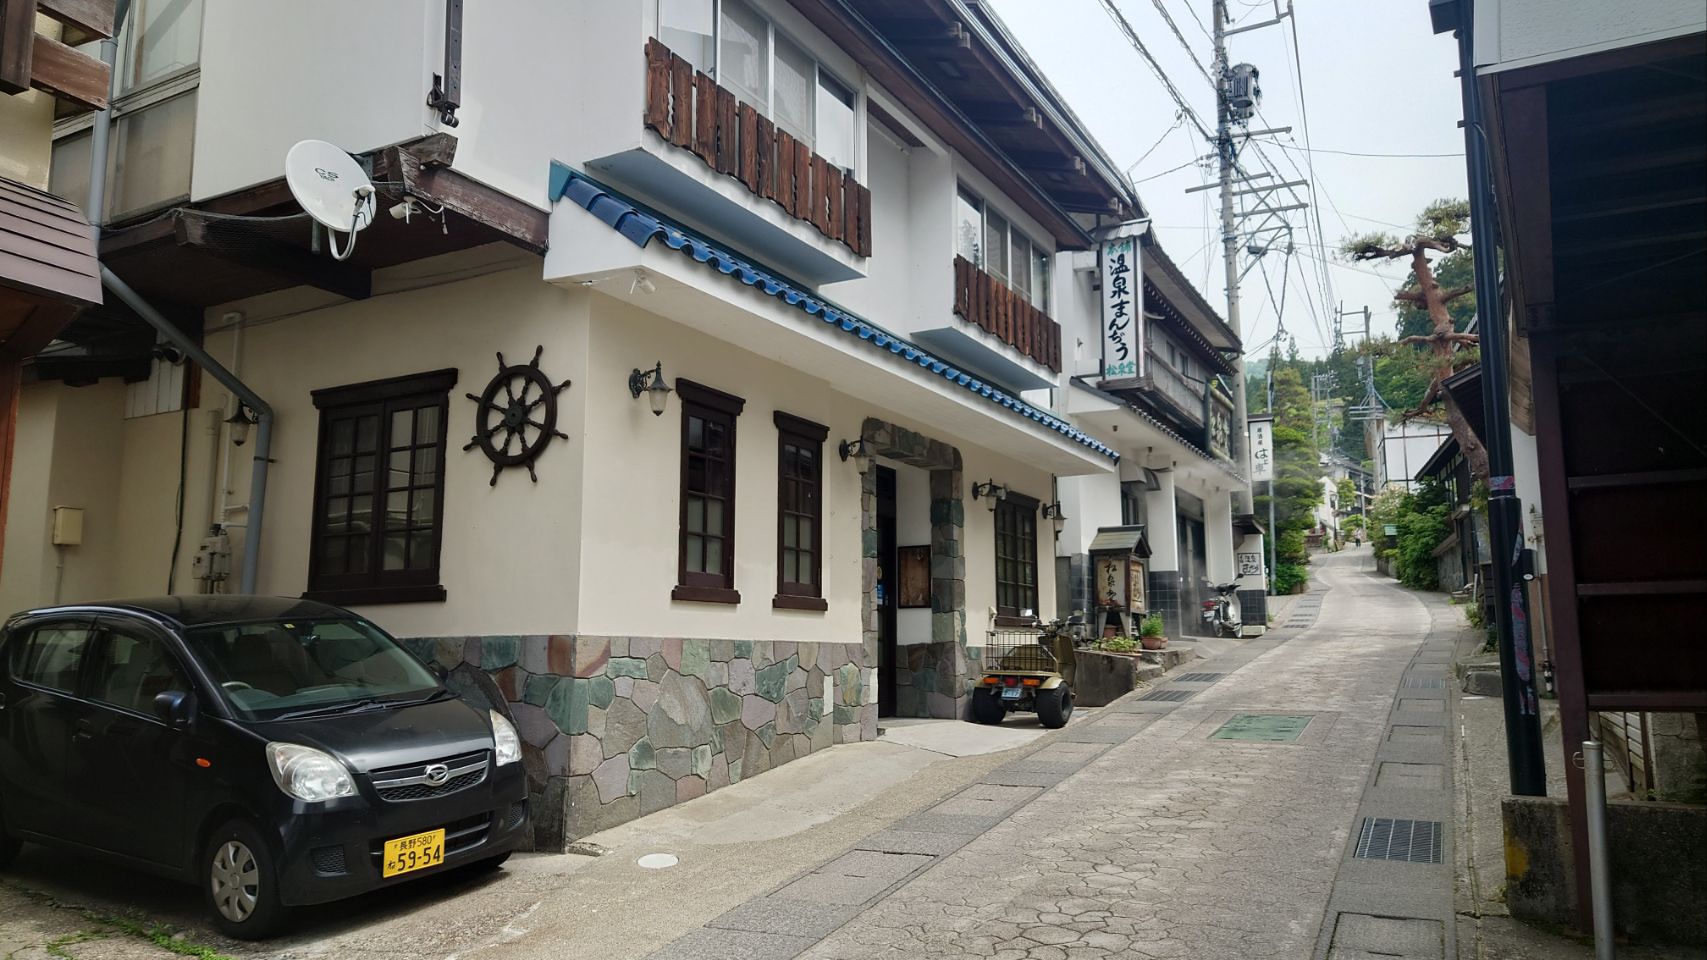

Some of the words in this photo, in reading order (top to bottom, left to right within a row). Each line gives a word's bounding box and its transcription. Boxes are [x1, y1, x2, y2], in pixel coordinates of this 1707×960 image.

[1108, 254, 1130, 360] 温泉まんぢう
[397, 844, 441, 871] 59-54
